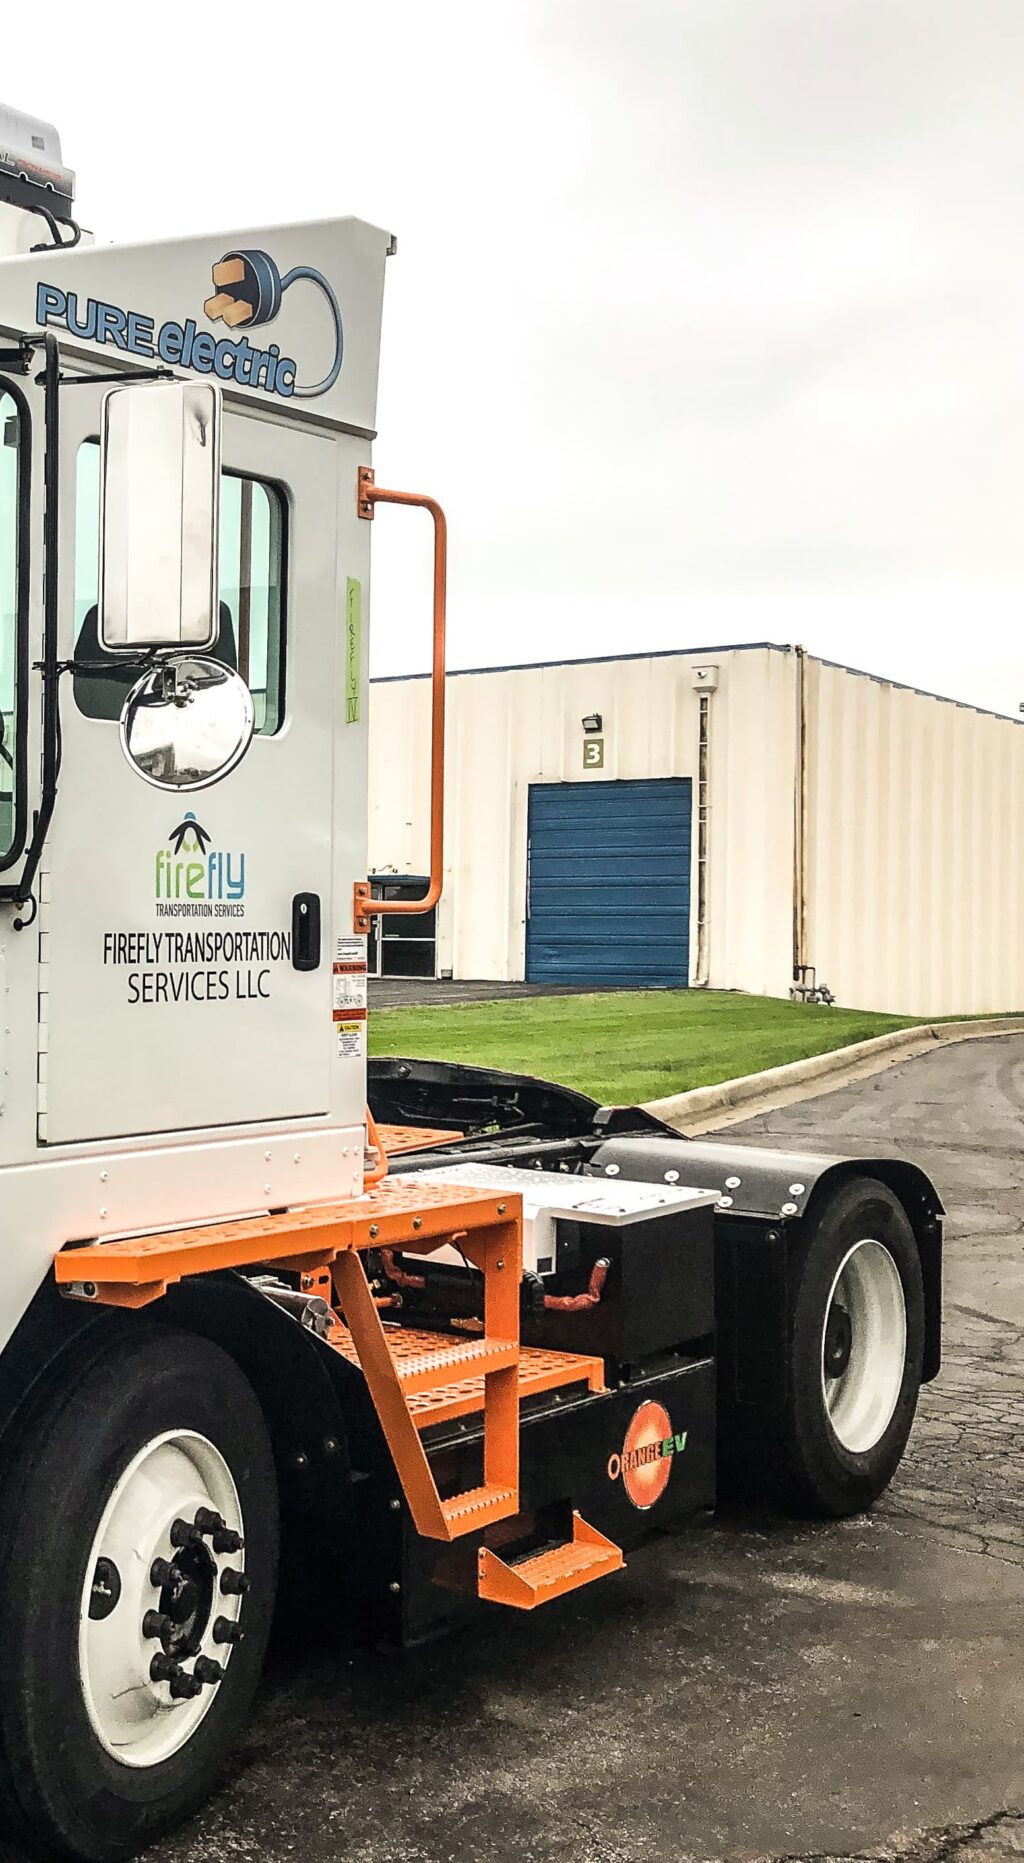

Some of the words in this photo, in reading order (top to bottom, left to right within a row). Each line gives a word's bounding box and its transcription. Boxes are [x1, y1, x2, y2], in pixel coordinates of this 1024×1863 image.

[36, 281, 155, 358] PURE
[157, 318, 297, 397] electric
[586, 743, 601, 764] 3
[155, 850, 245, 899] firefly
[155, 903, 213, 917] TRANSPORTATION
[214, 904, 245, 917] SERVICES
[103, 933, 163, 965] FIREFLY
[165, 931, 291, 963] TRANSPORTATION
[127, 970, 230, 1004] SERVICES
[236, 969, 271, 999] LLC
